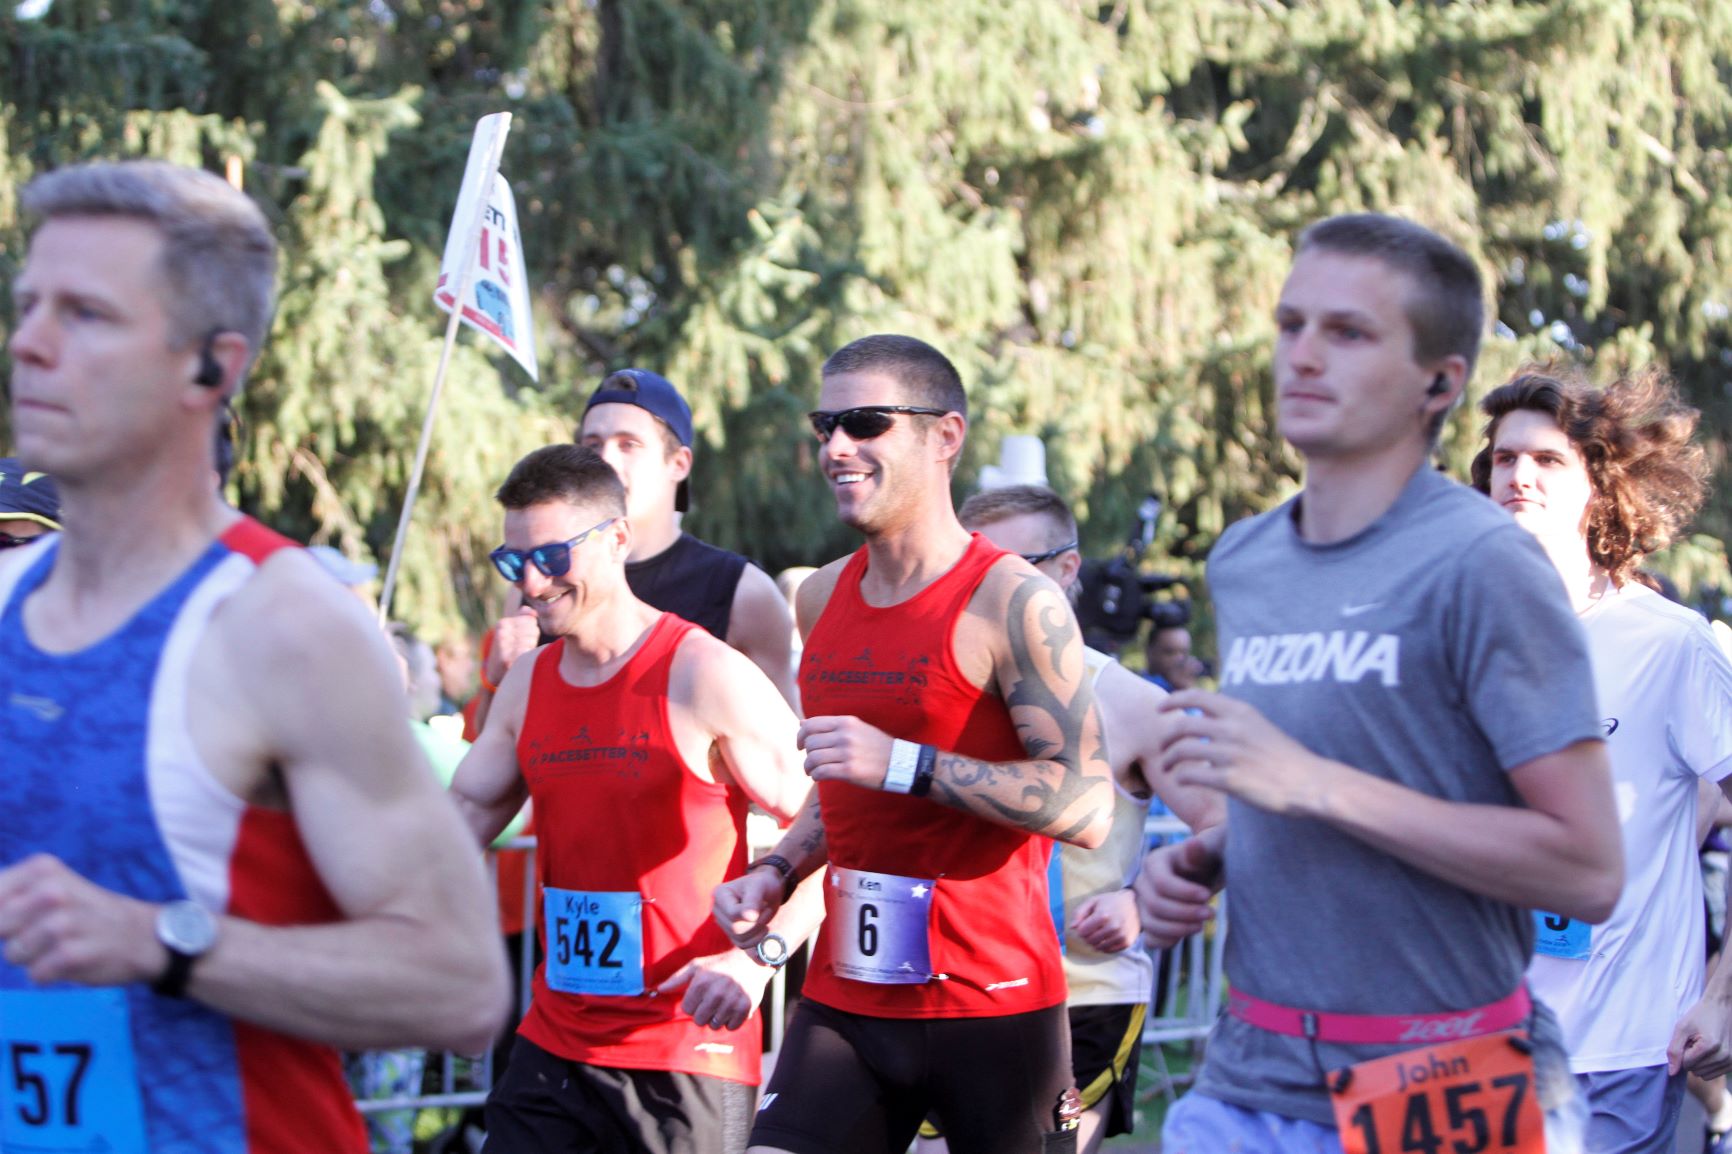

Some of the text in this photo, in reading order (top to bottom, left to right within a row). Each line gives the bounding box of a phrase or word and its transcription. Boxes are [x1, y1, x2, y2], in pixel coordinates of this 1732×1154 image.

[820, 671, 905, 685] PACESETTER
[1220, 630, 1400, 687] ARIZONA
[541, 747, 627, 763] PACESETTER
[858, 877, 882, 892] Ken
[565, 895, 600, 919] Kyle
[556, 916, 624, 968] 542
[858, 903, 879, 957] 6
[10, 1043, 92, 1127] 57
[1396, 1054, 1470, 1091] John
[1352, 1072, 1530, 1154] 1457
